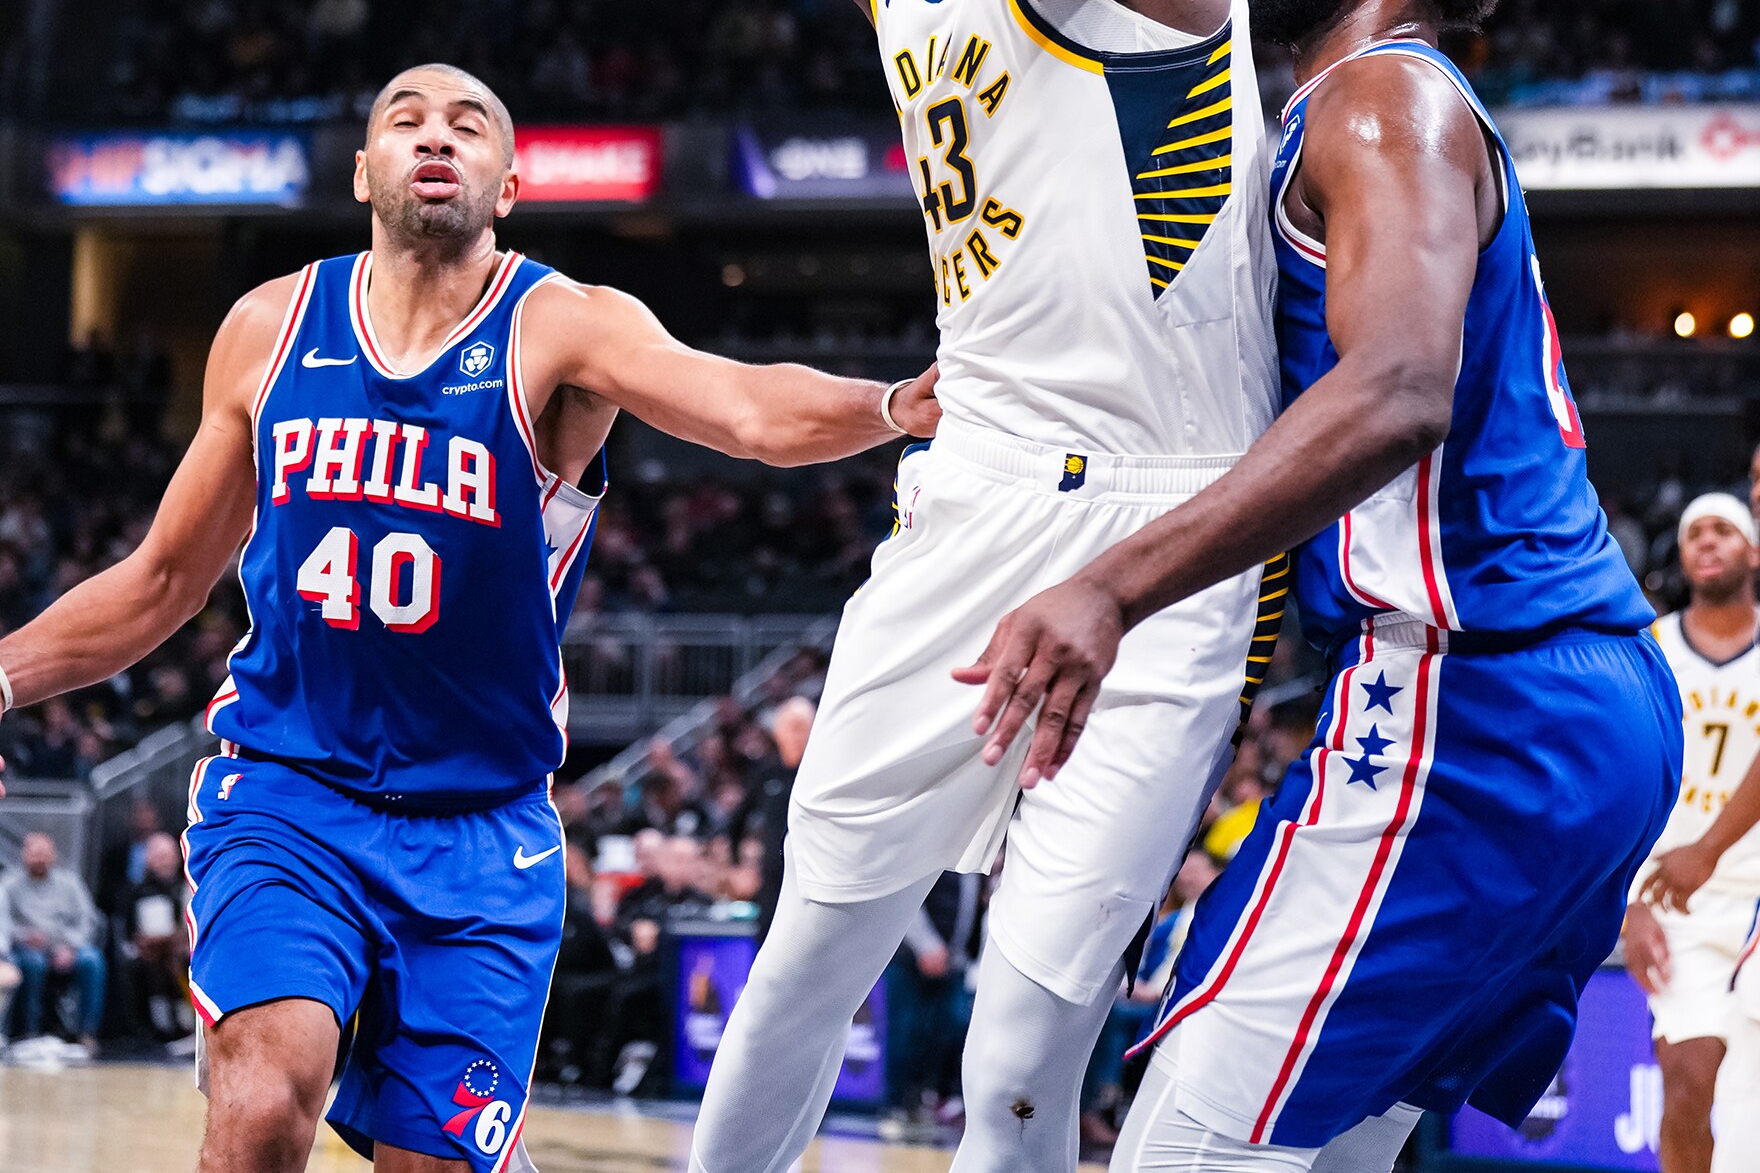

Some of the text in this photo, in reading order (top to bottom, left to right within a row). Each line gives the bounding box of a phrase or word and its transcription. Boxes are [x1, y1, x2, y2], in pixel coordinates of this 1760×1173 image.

[442, 379, 503, 395] crypto.com
[272, 418, 501, 529] PHILA
[297, 527, 442, 634] 40
[1702, 722, 1729, 777] 7
